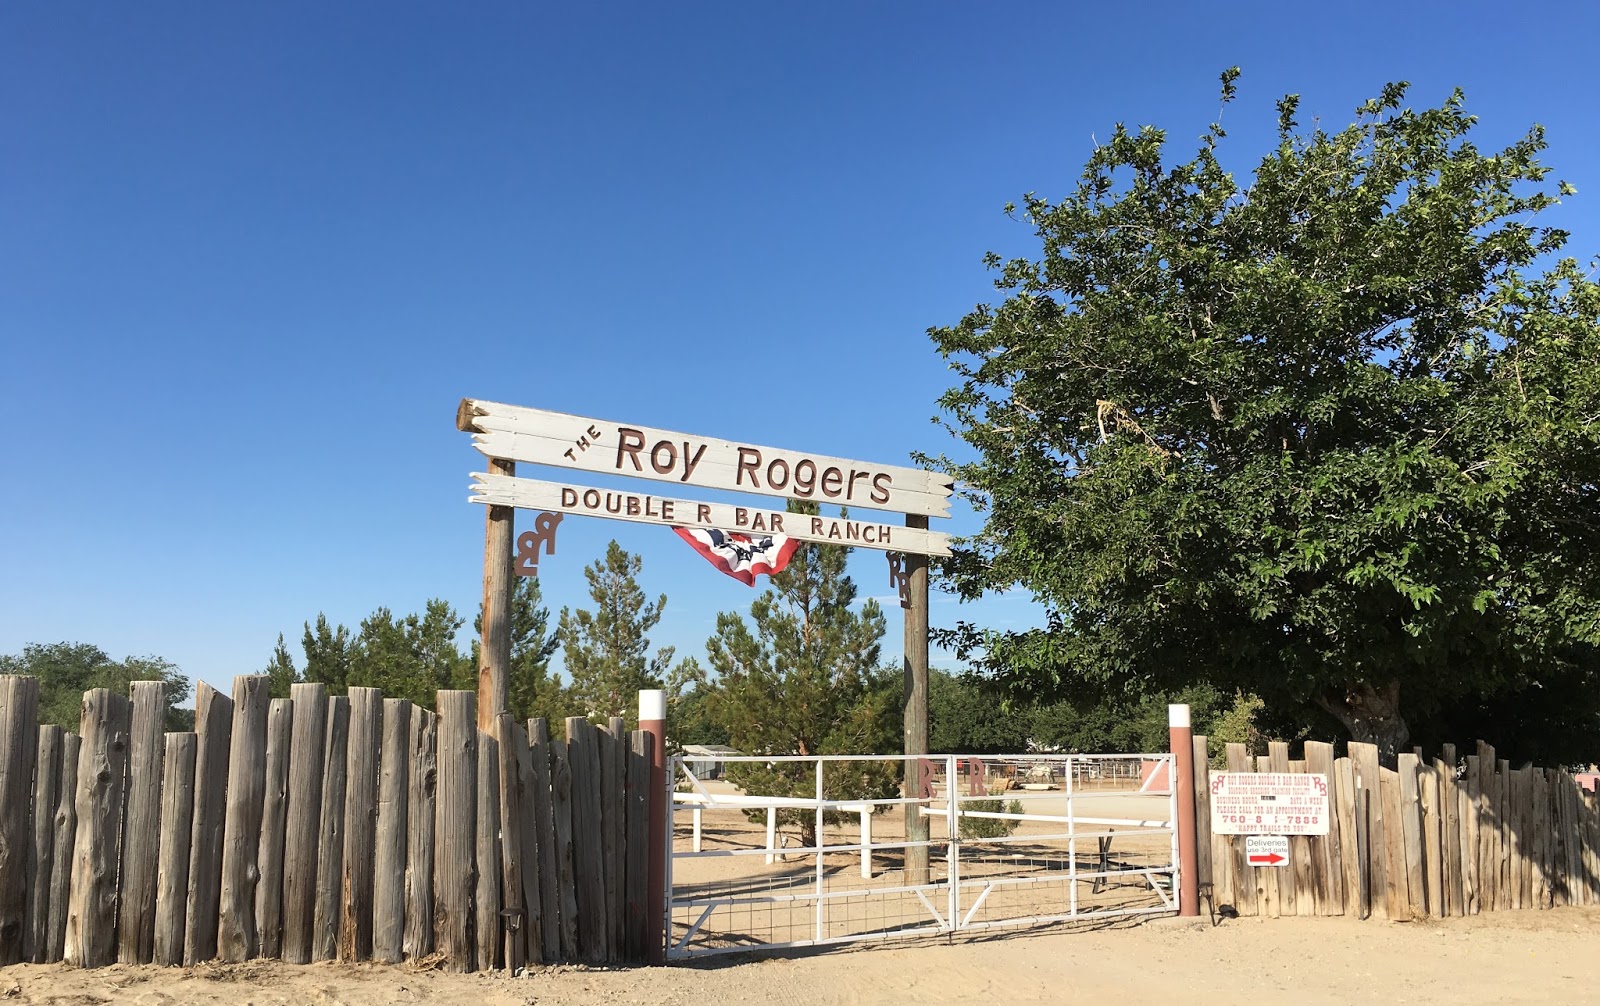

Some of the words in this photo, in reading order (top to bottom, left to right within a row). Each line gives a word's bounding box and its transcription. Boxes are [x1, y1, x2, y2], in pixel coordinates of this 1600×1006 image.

[564, 425, 601, 461] THE
[736, 446, 893, 504] Rogers
[561, 488, 675, 520] DOUBLE
[697, 503, 712, 524] R
[735, 508, 785, 533] BAR
[811, 517, 891, 544] RANCH
[1238, 775, 1256, 786] ROGERS
[1258, 775, 1276, 786] DOUBLE
[1294, 776, 1310, 787] RANCH
[1216, 796, 1240, 805] BUSINESS
[1309, 797, 1323, 806] WEEK
[1216, 805, 1237, 814] PLEASE
[1239, 805, 1252, 814] CALL
[1254, 806, 1264, 814] FOR
[1266, 806, 1273, 814] AN
[1275, 806, 1313, 815] APPOINTMENT
[1247, 839, 1287, 847] Deliveries
